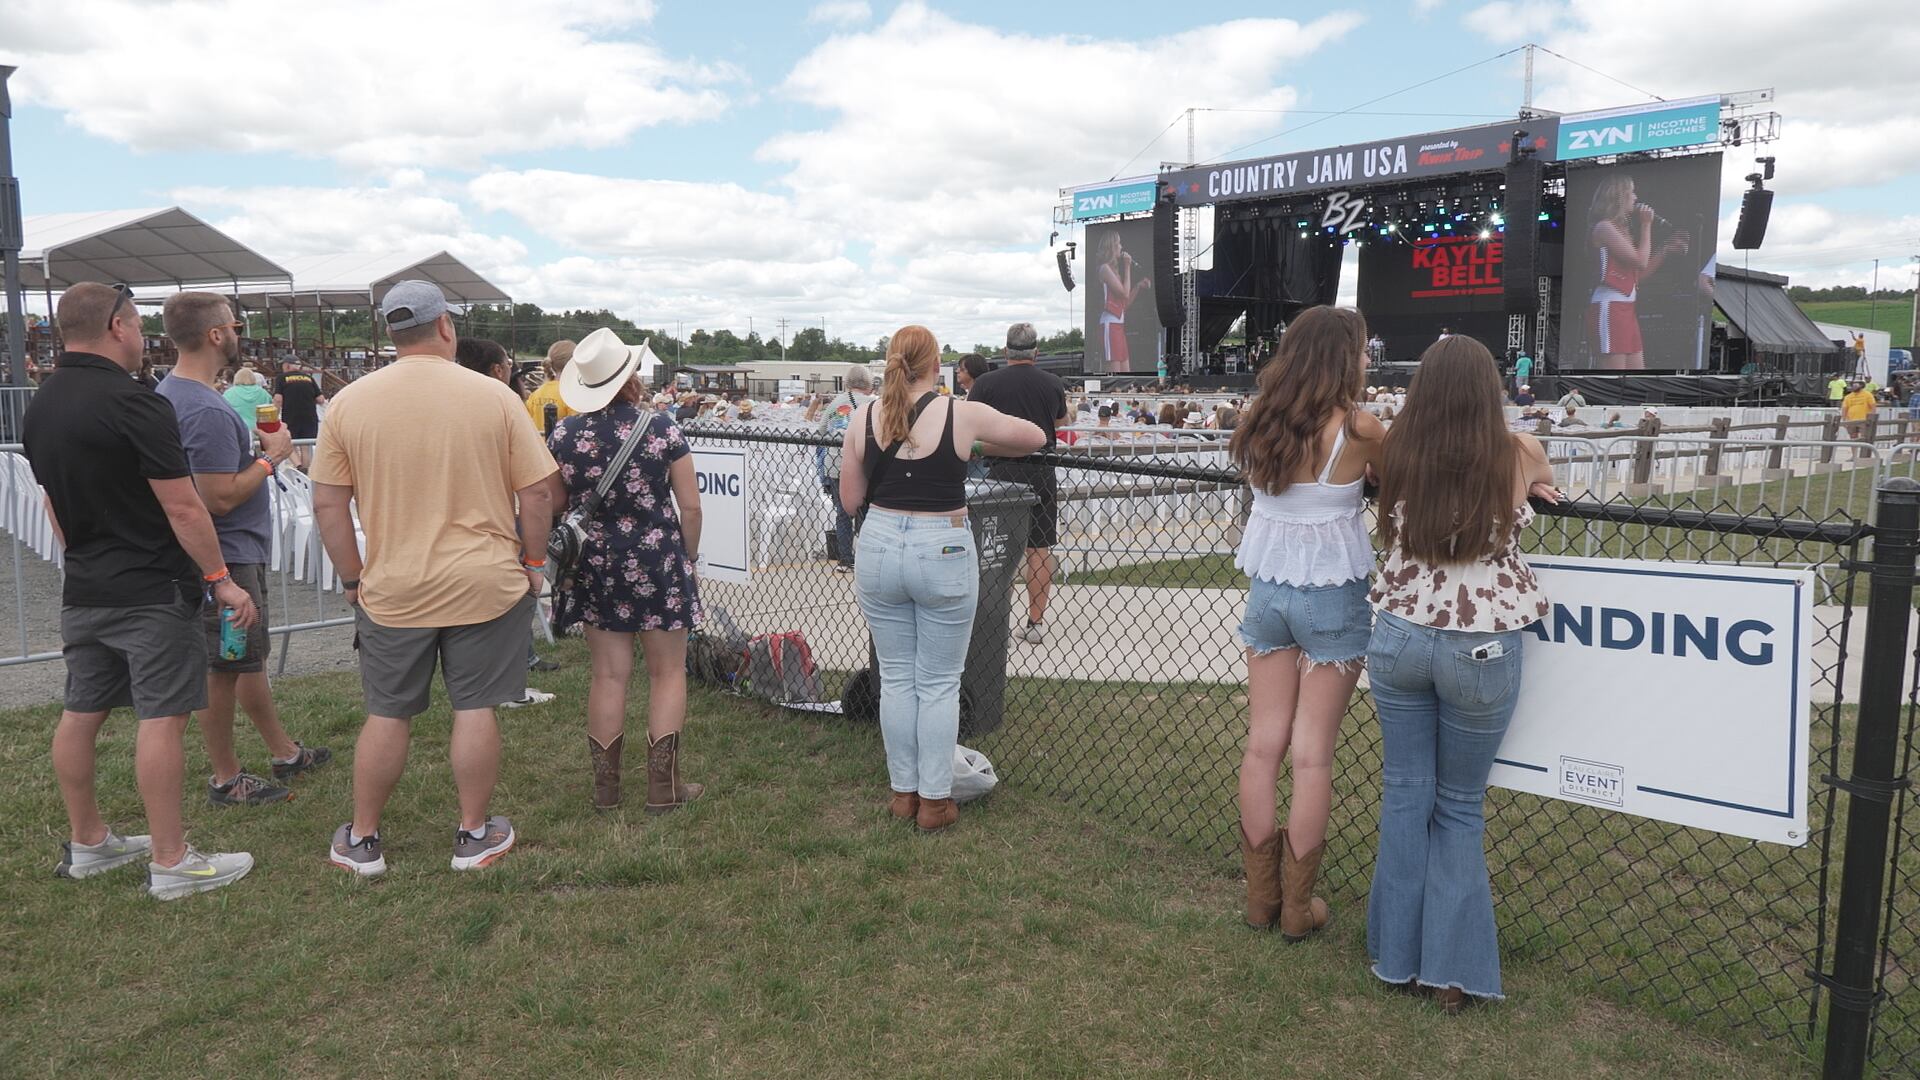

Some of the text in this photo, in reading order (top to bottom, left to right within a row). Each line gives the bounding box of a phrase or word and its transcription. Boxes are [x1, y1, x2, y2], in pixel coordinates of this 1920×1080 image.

[1647, 116, 1708, 130] NICOTINE
[1647, 124, 1707, 138] POUCHES
[1450, 140, 1459, 150] by
[1568, 124, 1634, 150] ZYN
[1208, 145, 1408, 198] COUNTRY JAM USA
[1078, 194, 1113, 212] ZYN
[1432, 264, 1501, 287] BELL
[696, 472, 740, 497] DING
[1565, 771, 1618, 791] EVENT
[1568, 784, 1614, 797] DISTRICT
